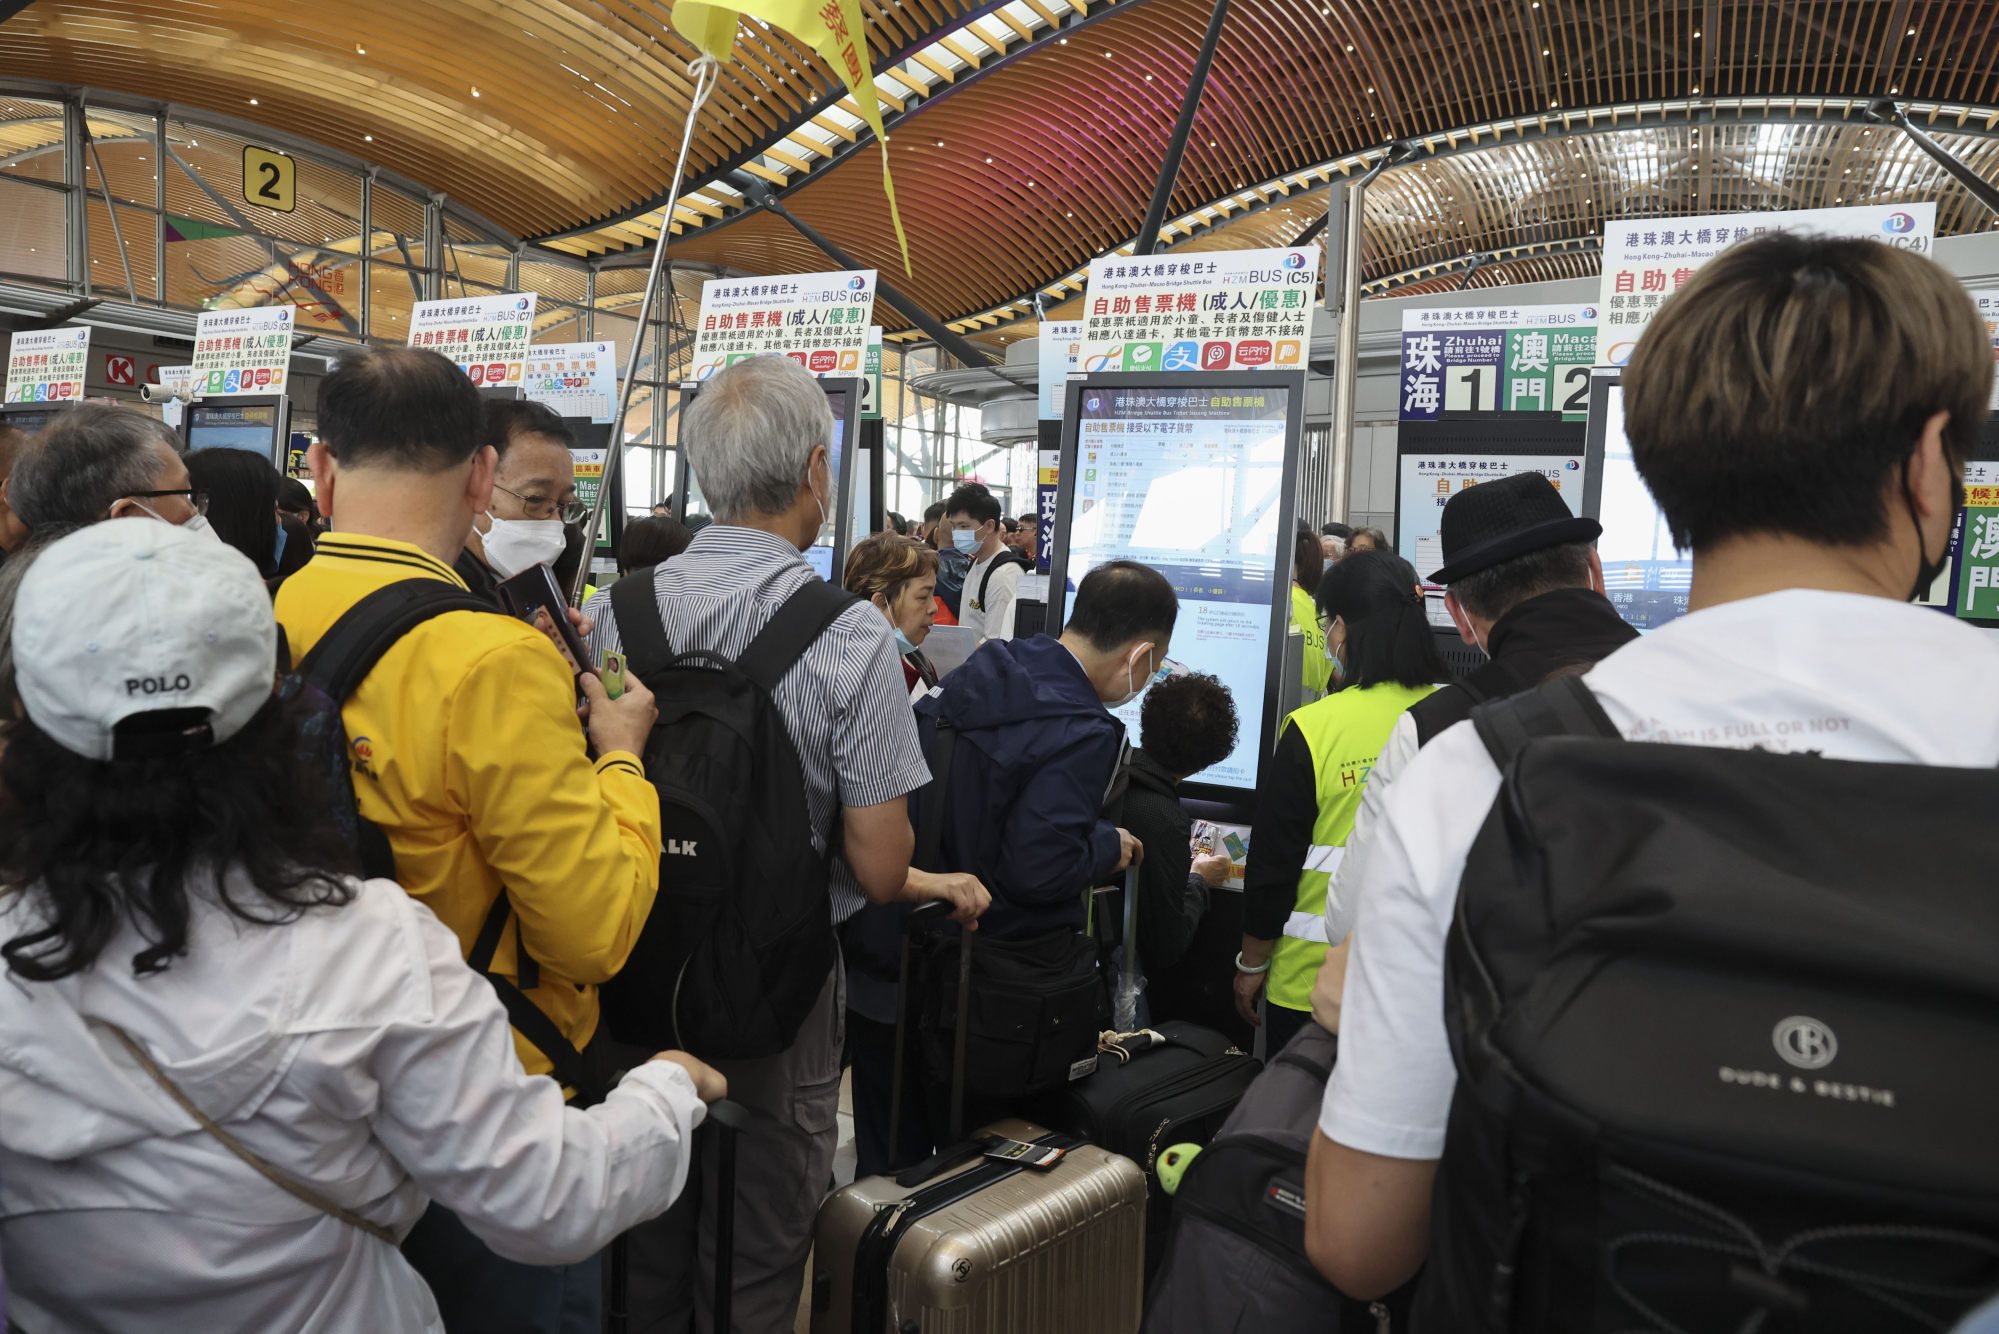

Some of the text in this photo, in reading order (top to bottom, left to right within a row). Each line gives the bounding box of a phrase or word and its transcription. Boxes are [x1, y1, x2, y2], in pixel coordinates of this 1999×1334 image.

[258, 161, 281, 201] 2
[1624, 254, 1641, 262] Hong
[289, 259, 332, 280] HONG
[1104, 261, 1217, 279] 港珠澳大橋穿梭巴士
[289, 274, 332, 296] KONG
[1249, 270, 1282, 283] BUS
[1286, 271, 1314, 285] (C5)
[713, 284, 798, 299] 港珠澳大橋穿梭巴士
[822, 290, 848, 302] BUS
[850, 292, 872, 303] (C6)
[1094, 289, 1307, 316] 自助售票機 (成人/優惠)
[420, 306, 482, 319] 港珠澳大橋穿梭巴士
[497, 310, 533, 323] BUS (C7)
[705, 306, 865, 330] 自助售票機 (成人/優惠)
[1421, 310, 1520, 322] 港珠澳大橋穿梭巴士
[1548, 314, 1576, 324] BUS
[264, 321, 278, 331] BUS
[278, 322, 292, 332] (C8)
[413, 325, 528, 346] 自助售票機 (成人/優惠)
[1445, 336, 1502, 346] Zhuhai
[198, 337, 242, 352] 自助售票機
[1404, 334, 1442, 414] 珠海
[1510, 332, 1550, 412] 澳門
[1461, 368, 1480, 411] 1
[1563, 367, 1591, 411] 2
[1114, 396, 1266, 408] 港珠澳大橋穿梭巴士 自助售票機
[1085, 422, 1194, 435] 自助售票機 接受以下電子貨幣
[1418, 462, 1508, 470] 港珠澳大橋穿梭巴士
[1614, 592, 1633, 603] 香港
[1306, 630, 1325, 650] BUS
[128, 674, 190, 697] POLO
[1723, 723, 1770, 740] FULL
[1774, 720, 1805, 737] OR
[1808, 716, 1852, 735] NOT
